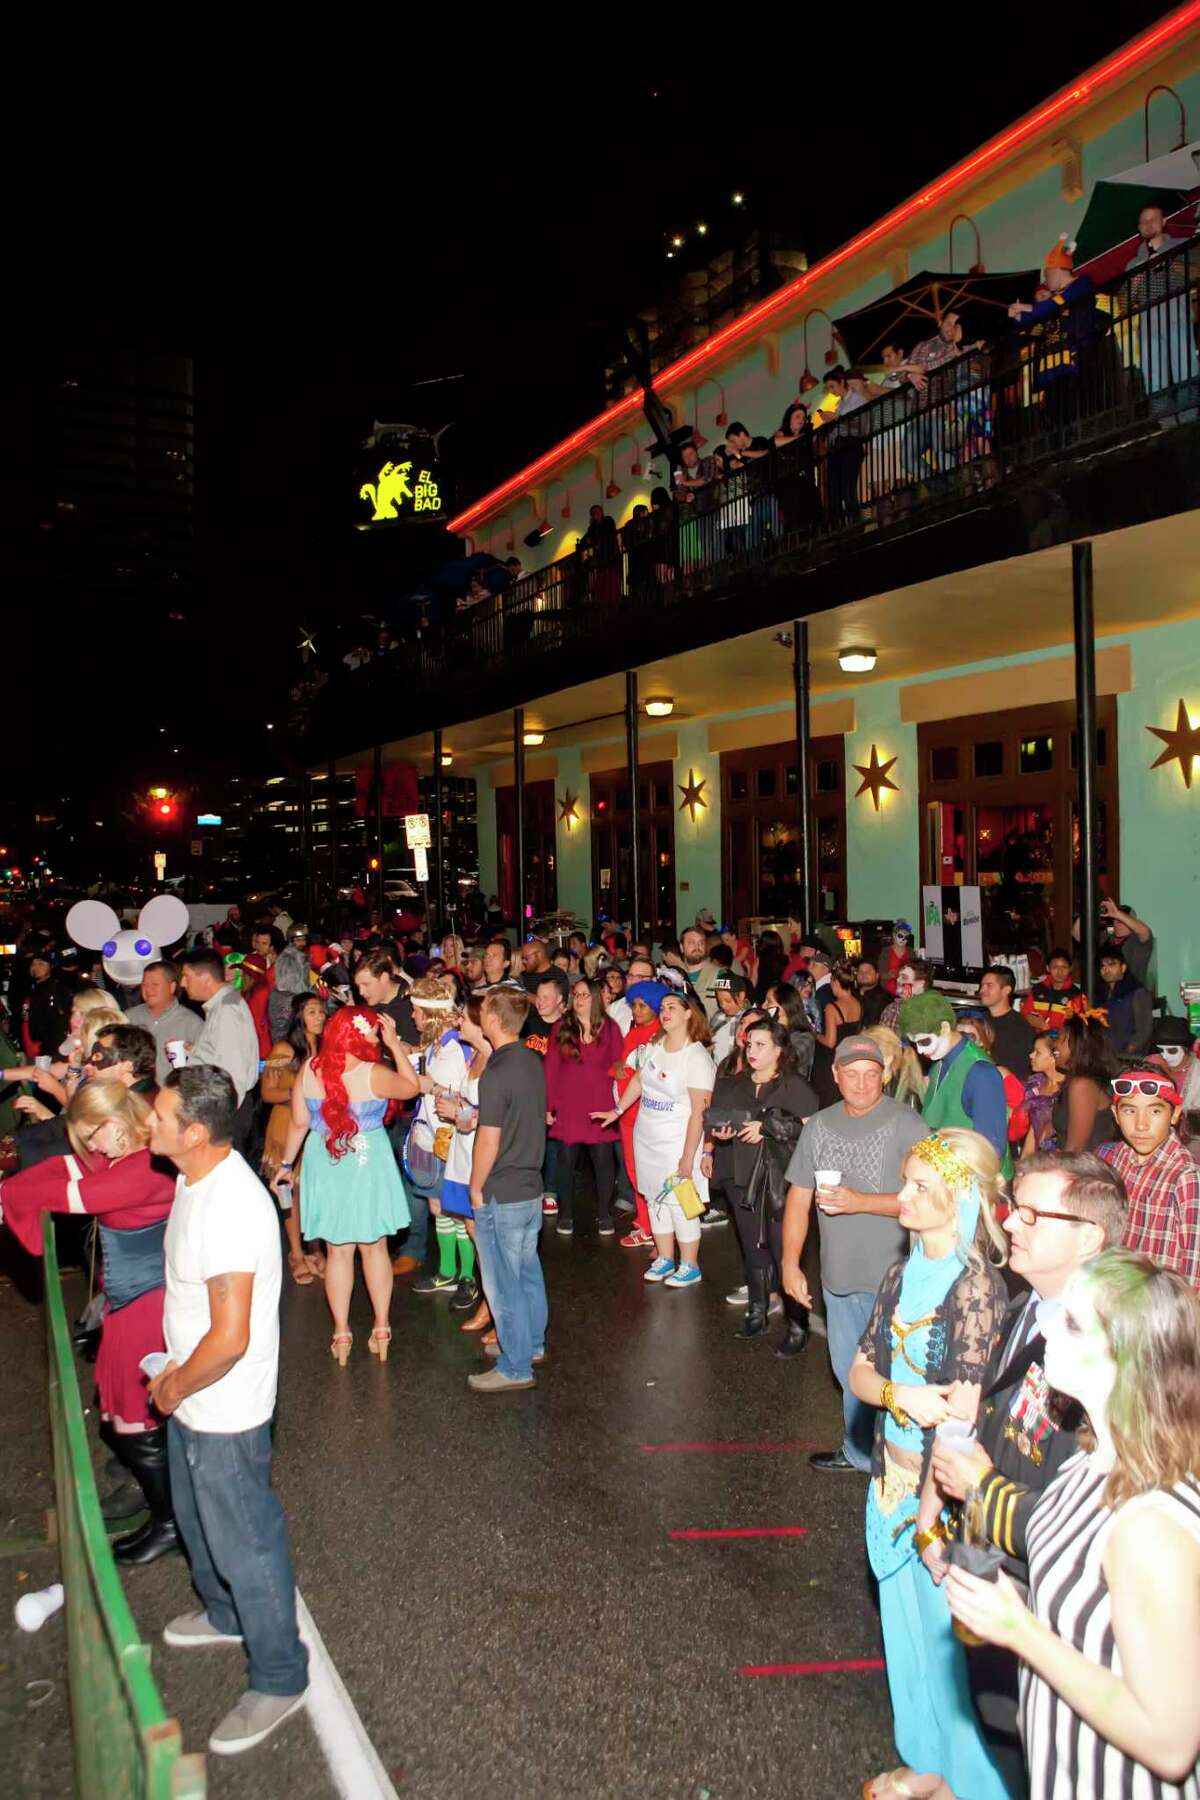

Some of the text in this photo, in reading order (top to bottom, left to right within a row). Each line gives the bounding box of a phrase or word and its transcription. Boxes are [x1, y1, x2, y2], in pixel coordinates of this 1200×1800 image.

[418, 470, 432, 484] EL
[414, 483, 438, 499] BIG
[414, 498, 442, 512] BAD
